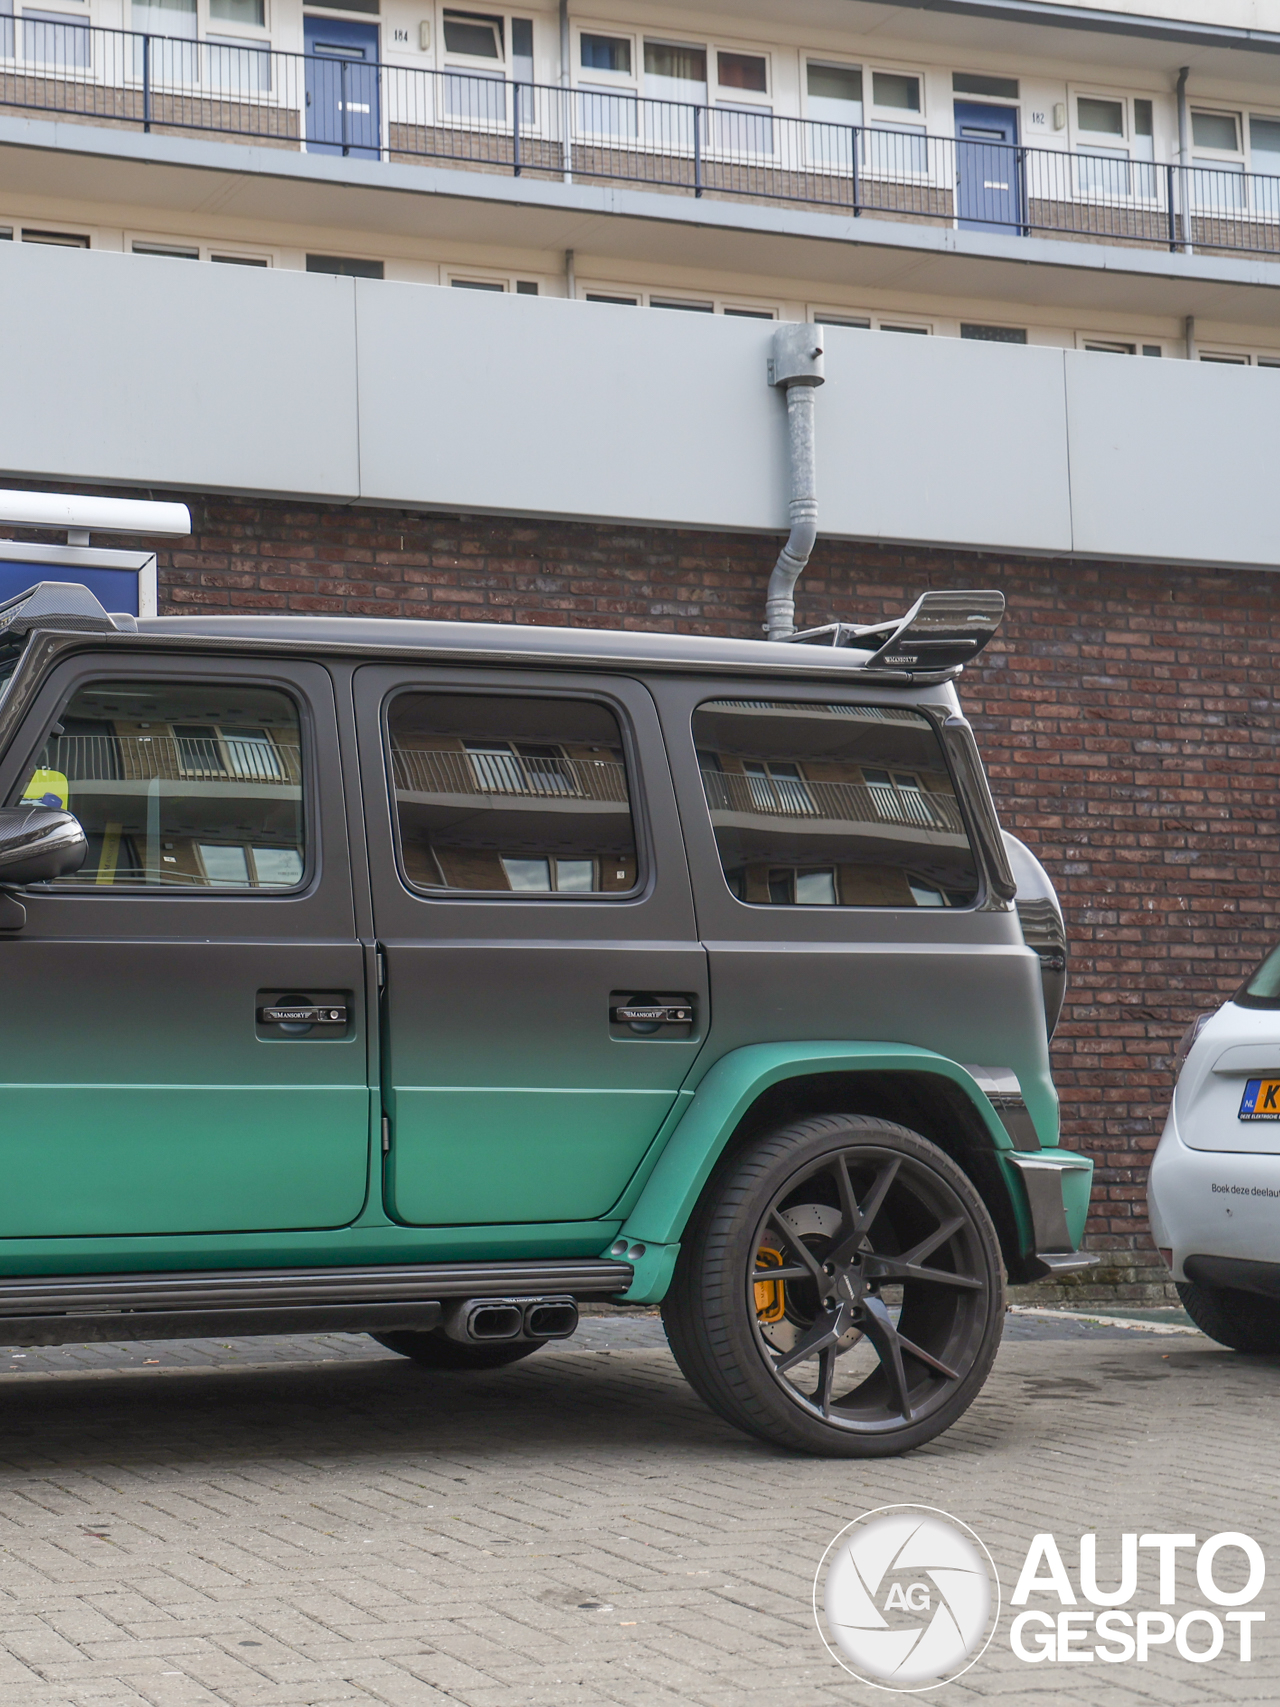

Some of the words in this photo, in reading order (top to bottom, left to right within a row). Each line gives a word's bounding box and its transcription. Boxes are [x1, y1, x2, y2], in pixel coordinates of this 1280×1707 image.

[394, 29, 408, 41] 184
[1032, 112, 1045, 124] 182
[277, 1011, 304, 1019] MANSORY
[1263, 1084, 1280, 1109] K
[1244, 1099, 1254, 1108] NL
[1211, 1183, 1230, 1194] Boek
[1230, 1184, 1250, 1196] deze
[1250, 1186, 1280, 1198] deelau
